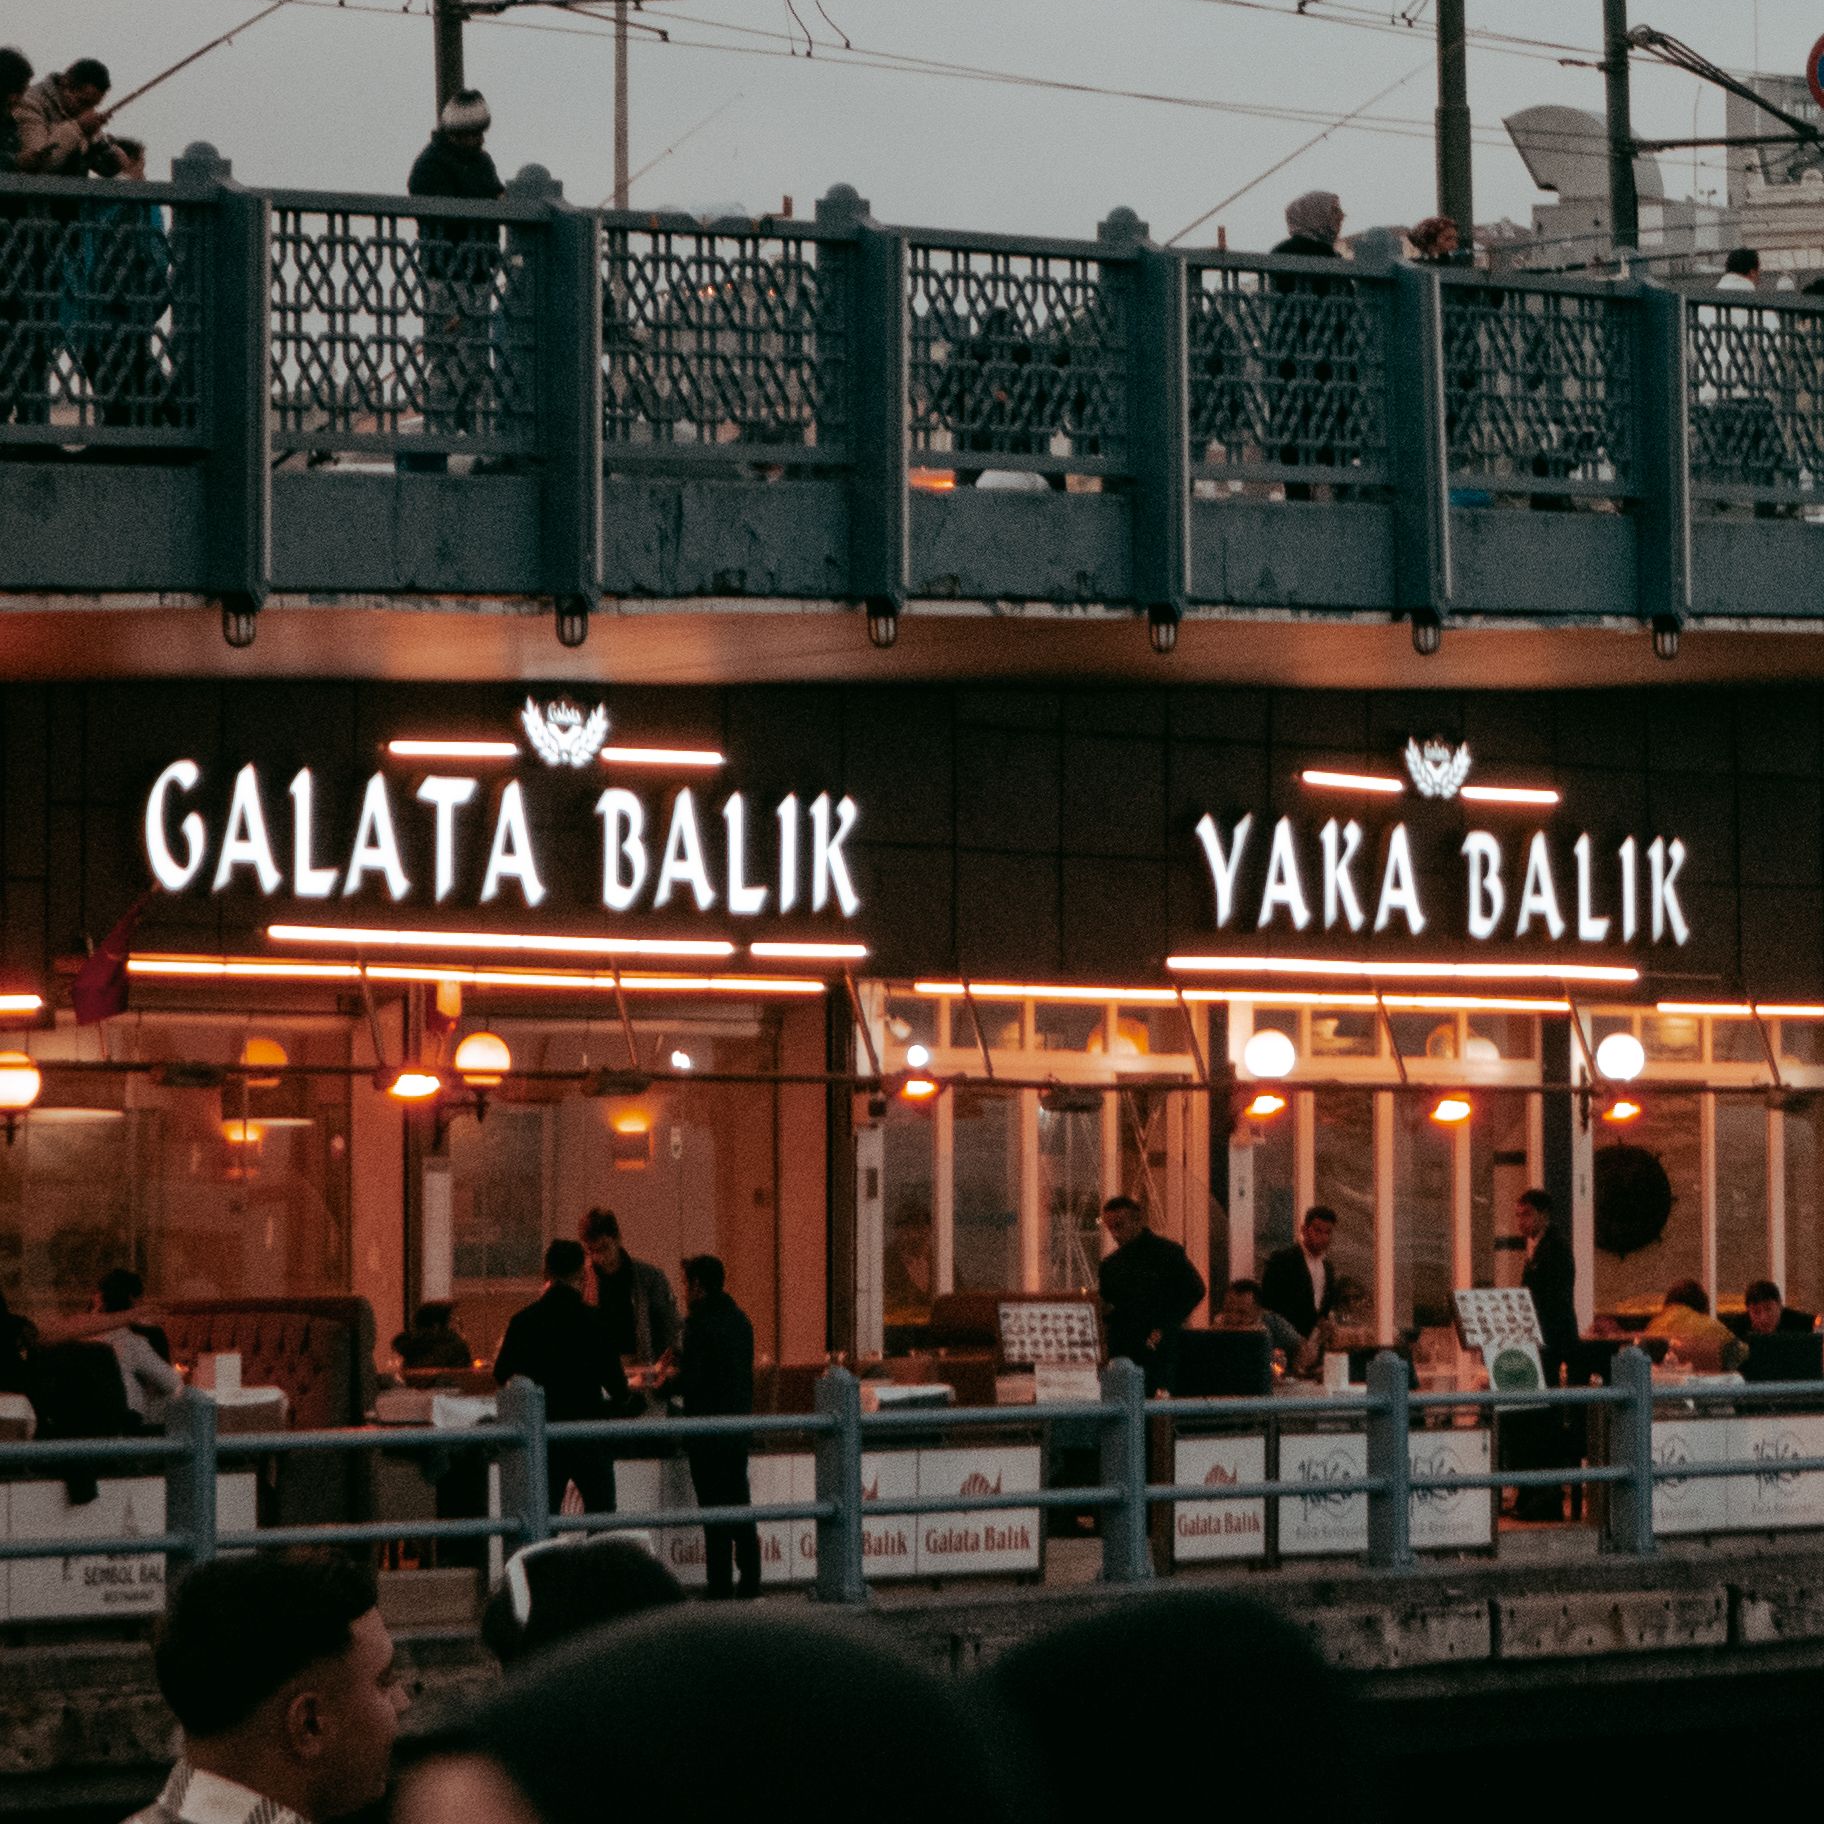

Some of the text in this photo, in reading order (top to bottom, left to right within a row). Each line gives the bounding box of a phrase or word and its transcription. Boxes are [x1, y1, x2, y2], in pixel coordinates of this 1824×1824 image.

[145, 759, 862, 918] GALATA BALIK
[1195, 812, 1691, 946] YAKA BALIK
[925, 1526, 1031, 1555] Galata Balık
[1178, 1512, 1221, 1538] Galata
